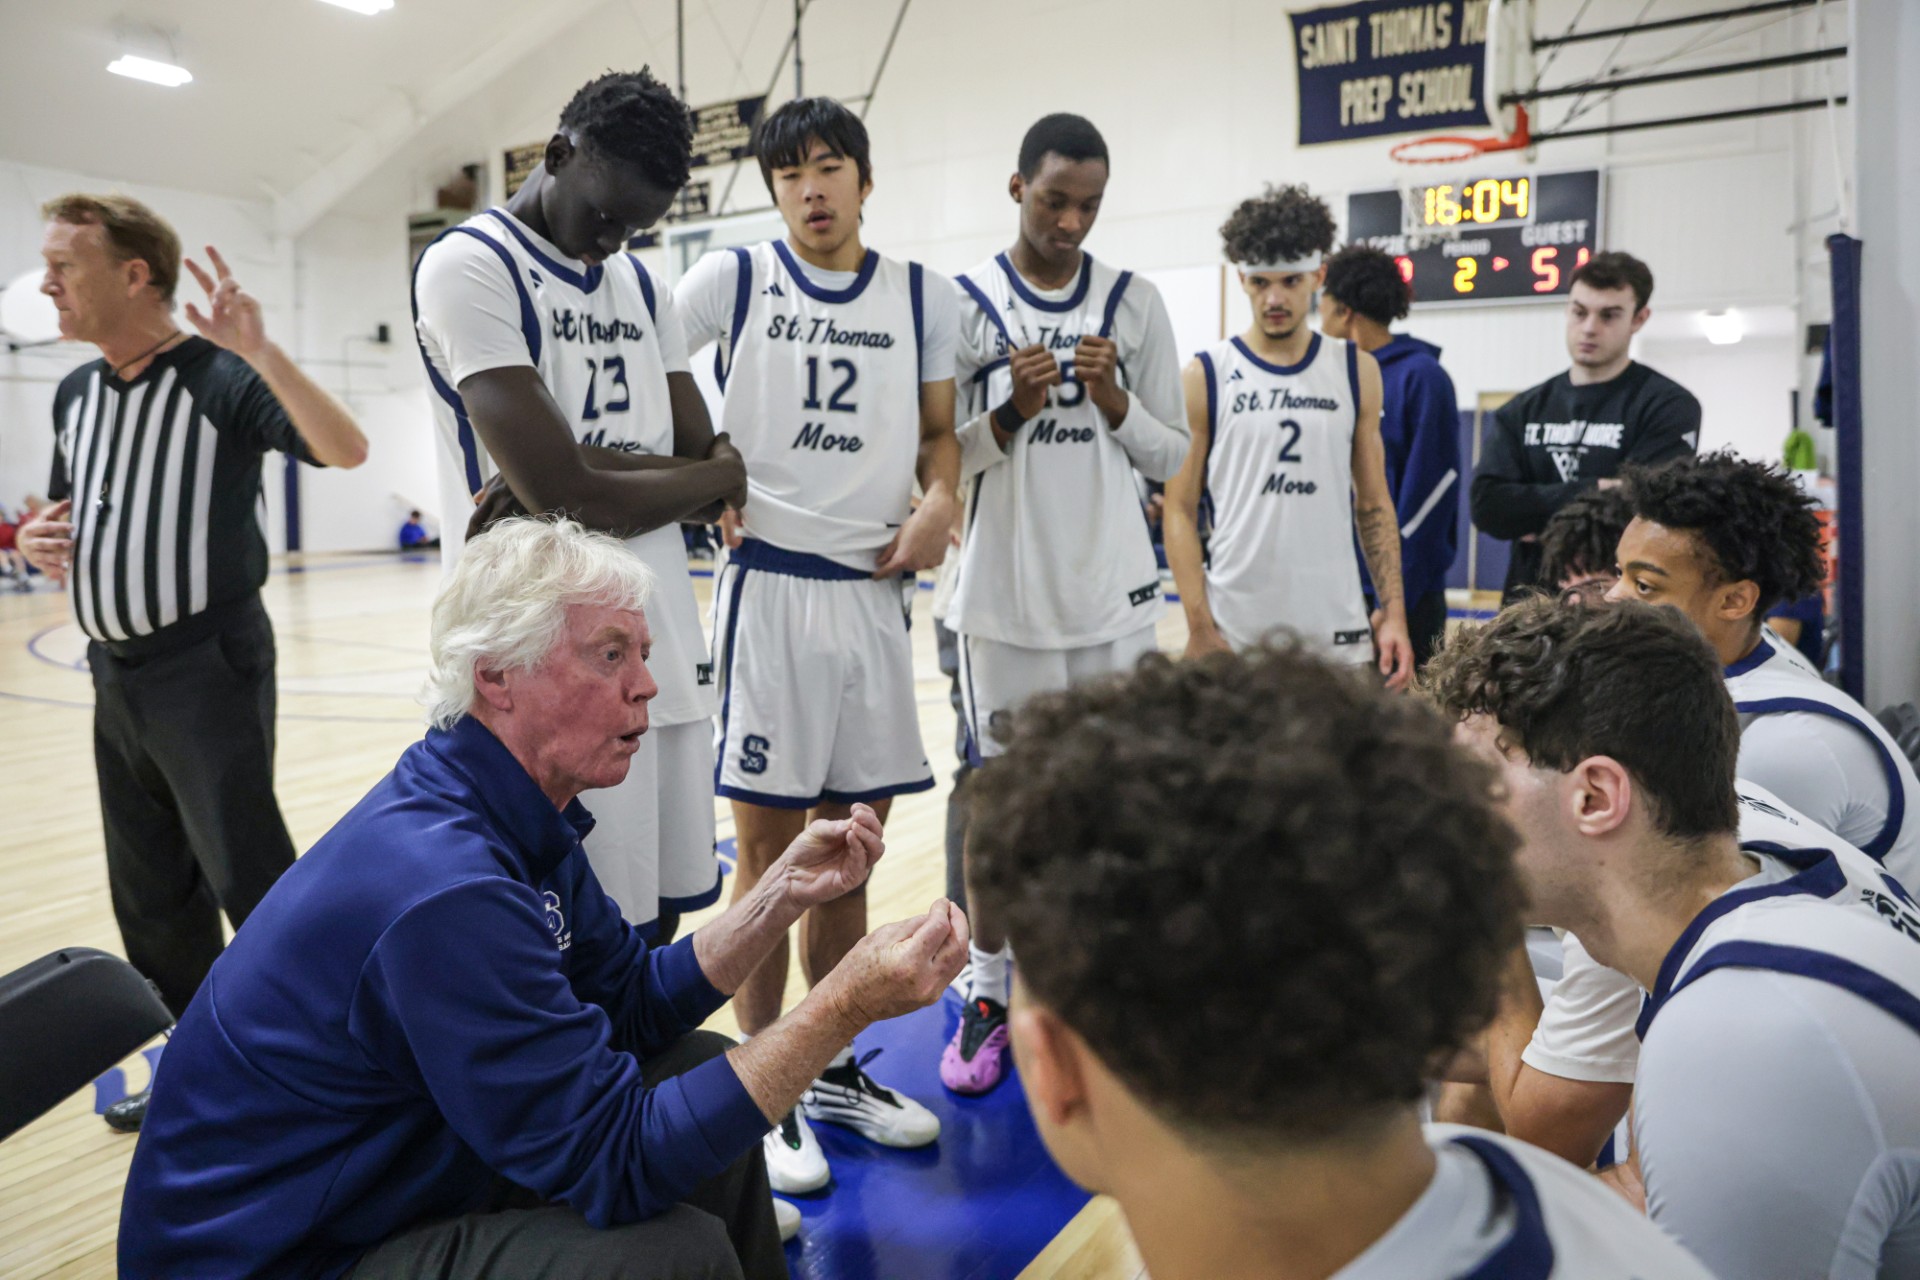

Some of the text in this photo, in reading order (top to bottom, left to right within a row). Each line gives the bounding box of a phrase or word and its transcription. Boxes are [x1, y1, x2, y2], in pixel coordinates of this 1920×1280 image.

[1300, 16, 1360, 69] SAINT
[1369, 2, 1453, 59] THOMAS
[1340, 64, 1476, 126] PREP SCHOOL
[1425, 178, 1529, 225] 16:04
[1521, 220, 1588, 246] GUEST
[1453, 257, 1477, 293] 2
[1039, 326, 1083, 350] Tho
[802, 355, 858, 414] 12
[1269, 388, 1339, 411] Thomas
[791, 422, 863, 452] More
[1027, 419, 1095, 444] More
[1278, 418, 1302, 463] 2
[1542, 420, 1587, 445] THO
[1261, 473, 1317, 495] More
